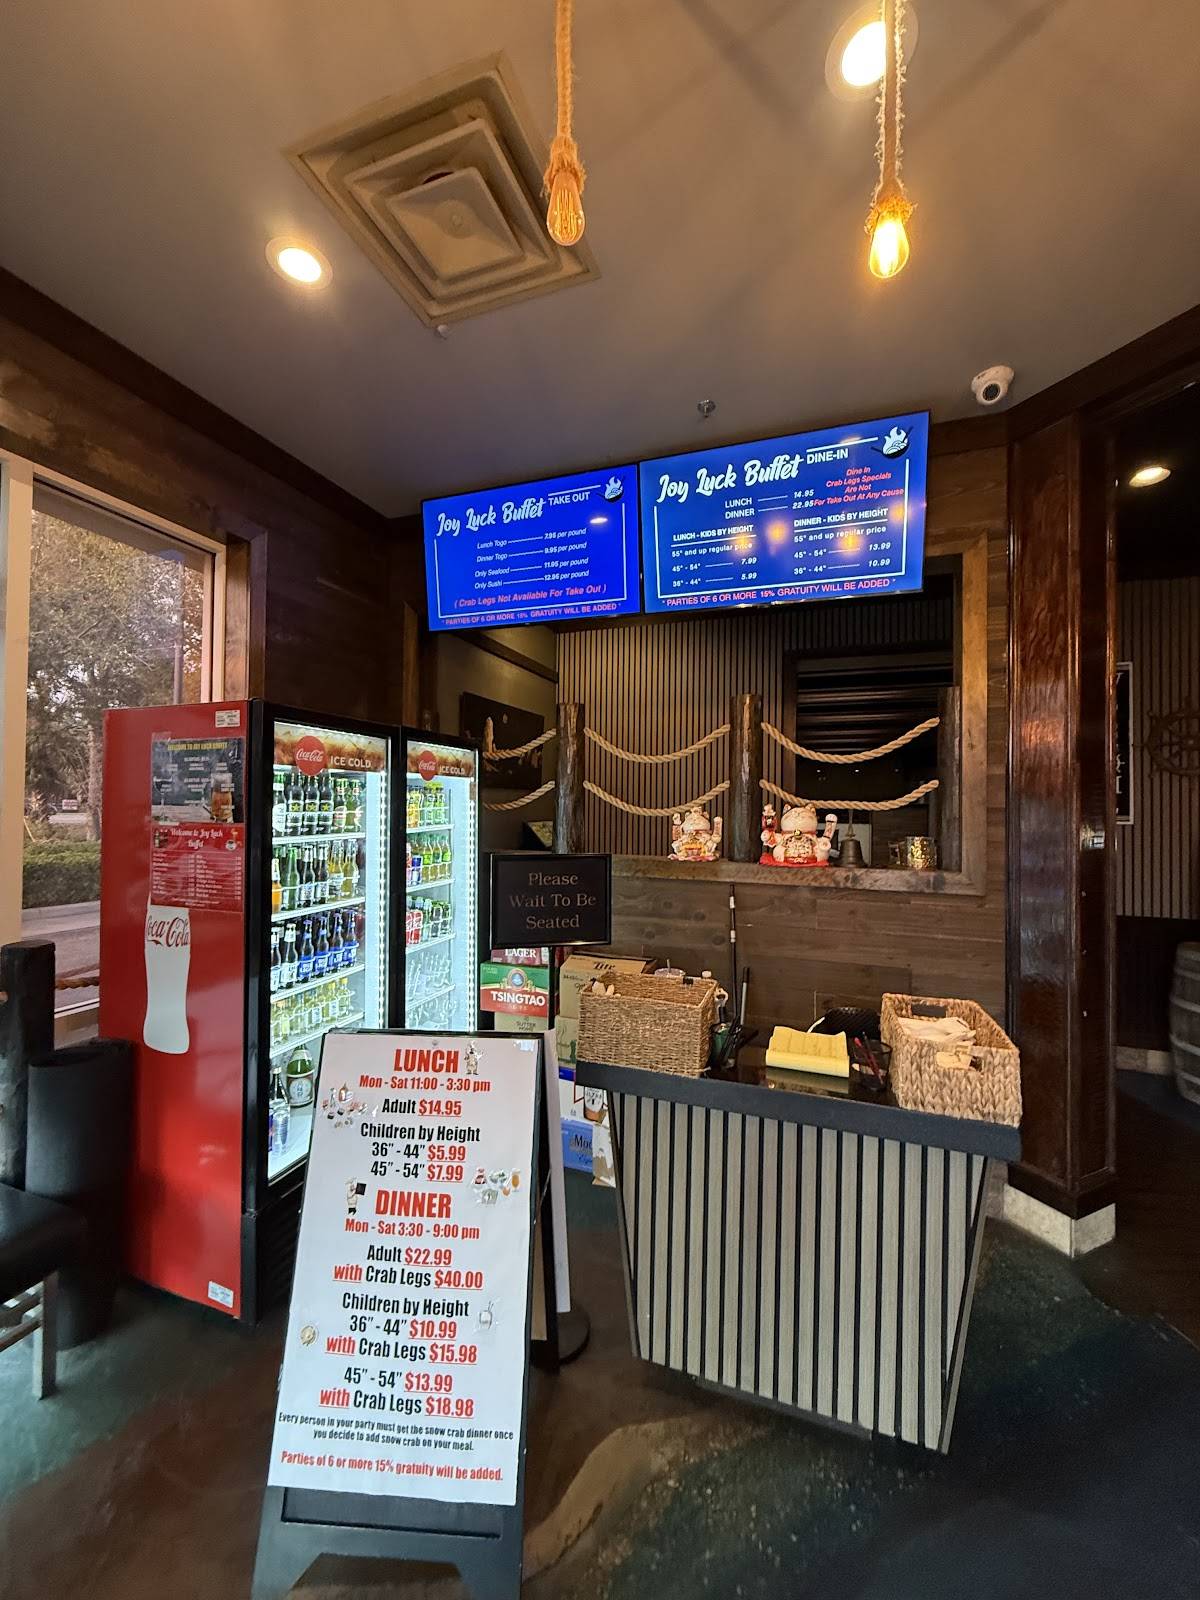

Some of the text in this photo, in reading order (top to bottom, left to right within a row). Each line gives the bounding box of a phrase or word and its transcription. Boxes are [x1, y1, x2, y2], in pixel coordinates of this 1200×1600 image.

[656, 448, 848, 503] Joy Luck Buffet DINE-IN
[725, 489, 814, 508] LUNCH 14.95
[436, 491, 590, 536] Joy Luck Buffet TAKE OUT
[725, 500, 814, 520] DINNER 22.95
[794, 518, 822, 527] DINNER
[847, 512, 858, 520] BY
[858, 508, 888, 518] HEIGHT
[673, 532, 696, 542] LUNCH
[717, 528, 727, 536] BY
[728, 524, 754, 534] HEIGHT
[550, 588, 562, 598] For
[565, 587, 584, 596] Take
[586, 585, 602, 594] Out
[667, 596, 698, 606] PARTIES
[700, 596, 712, 604] OF
[719, 594, 731, 602] OR
[732, 592, 756, 600] MORE
[778, 586, 820, 597] GRATUITY
[822, 583, 842, 592] WILL
[844, 582, 856, 590] BE
[858, 578, 890, 590] ADDED
[330, 756, 371, 768] ICE COLD
[440, 764, 465, 776] ICE COLD
[528, 872, 578, 886] Please
[509, 893, 596, 908] Wait To Be
[526, 914, 580, 930] Seated
[504, 948, 537, 958] LAGER
[490, 991, 546, 1006] TSINGTAO
[394, 1048, 460, 1074] LUNCH
[360, 1075, 491, 1092] Mon Sat 11:00 3:30 pm
[382, 1098, 462, 1116] Adult $14.95
[360, 1122, 480, 1143] Children by Height
[372, 1142, 466, 1161] 36" 44" $5.99
[370, 1161, 464, 1181] 45" 54" $7.99
[376, 1190, 452, 1218] DINNER
[345, 1218, 480, 1240] Mon Sat 3:30 9:00 pm
[367, 1244, 452, 1266] Adult $22.99
[334, 1264, 483, 1288] with Crab Legs $40.00
[342, 1292, 470, 1318] Children by Height
[350, 1314, 457, 1338] 36" 44" $10.99
[326, 1336, 478, 1364] with Crab Legs $15.98
[344, 1366, 452, 1392] 45" 54" $13.99
[320, 1388, 474, 1417] with Crab Legs $18.98
[278, 1412, 514, 1440] Every person in your party must get the snow crab dinner once
[314, 1429, 474, 1451] you decide to add snow crab on your meal.
[281, 1450, 504, 1481] Parties of 6 or more 15% gratuity will be added.
